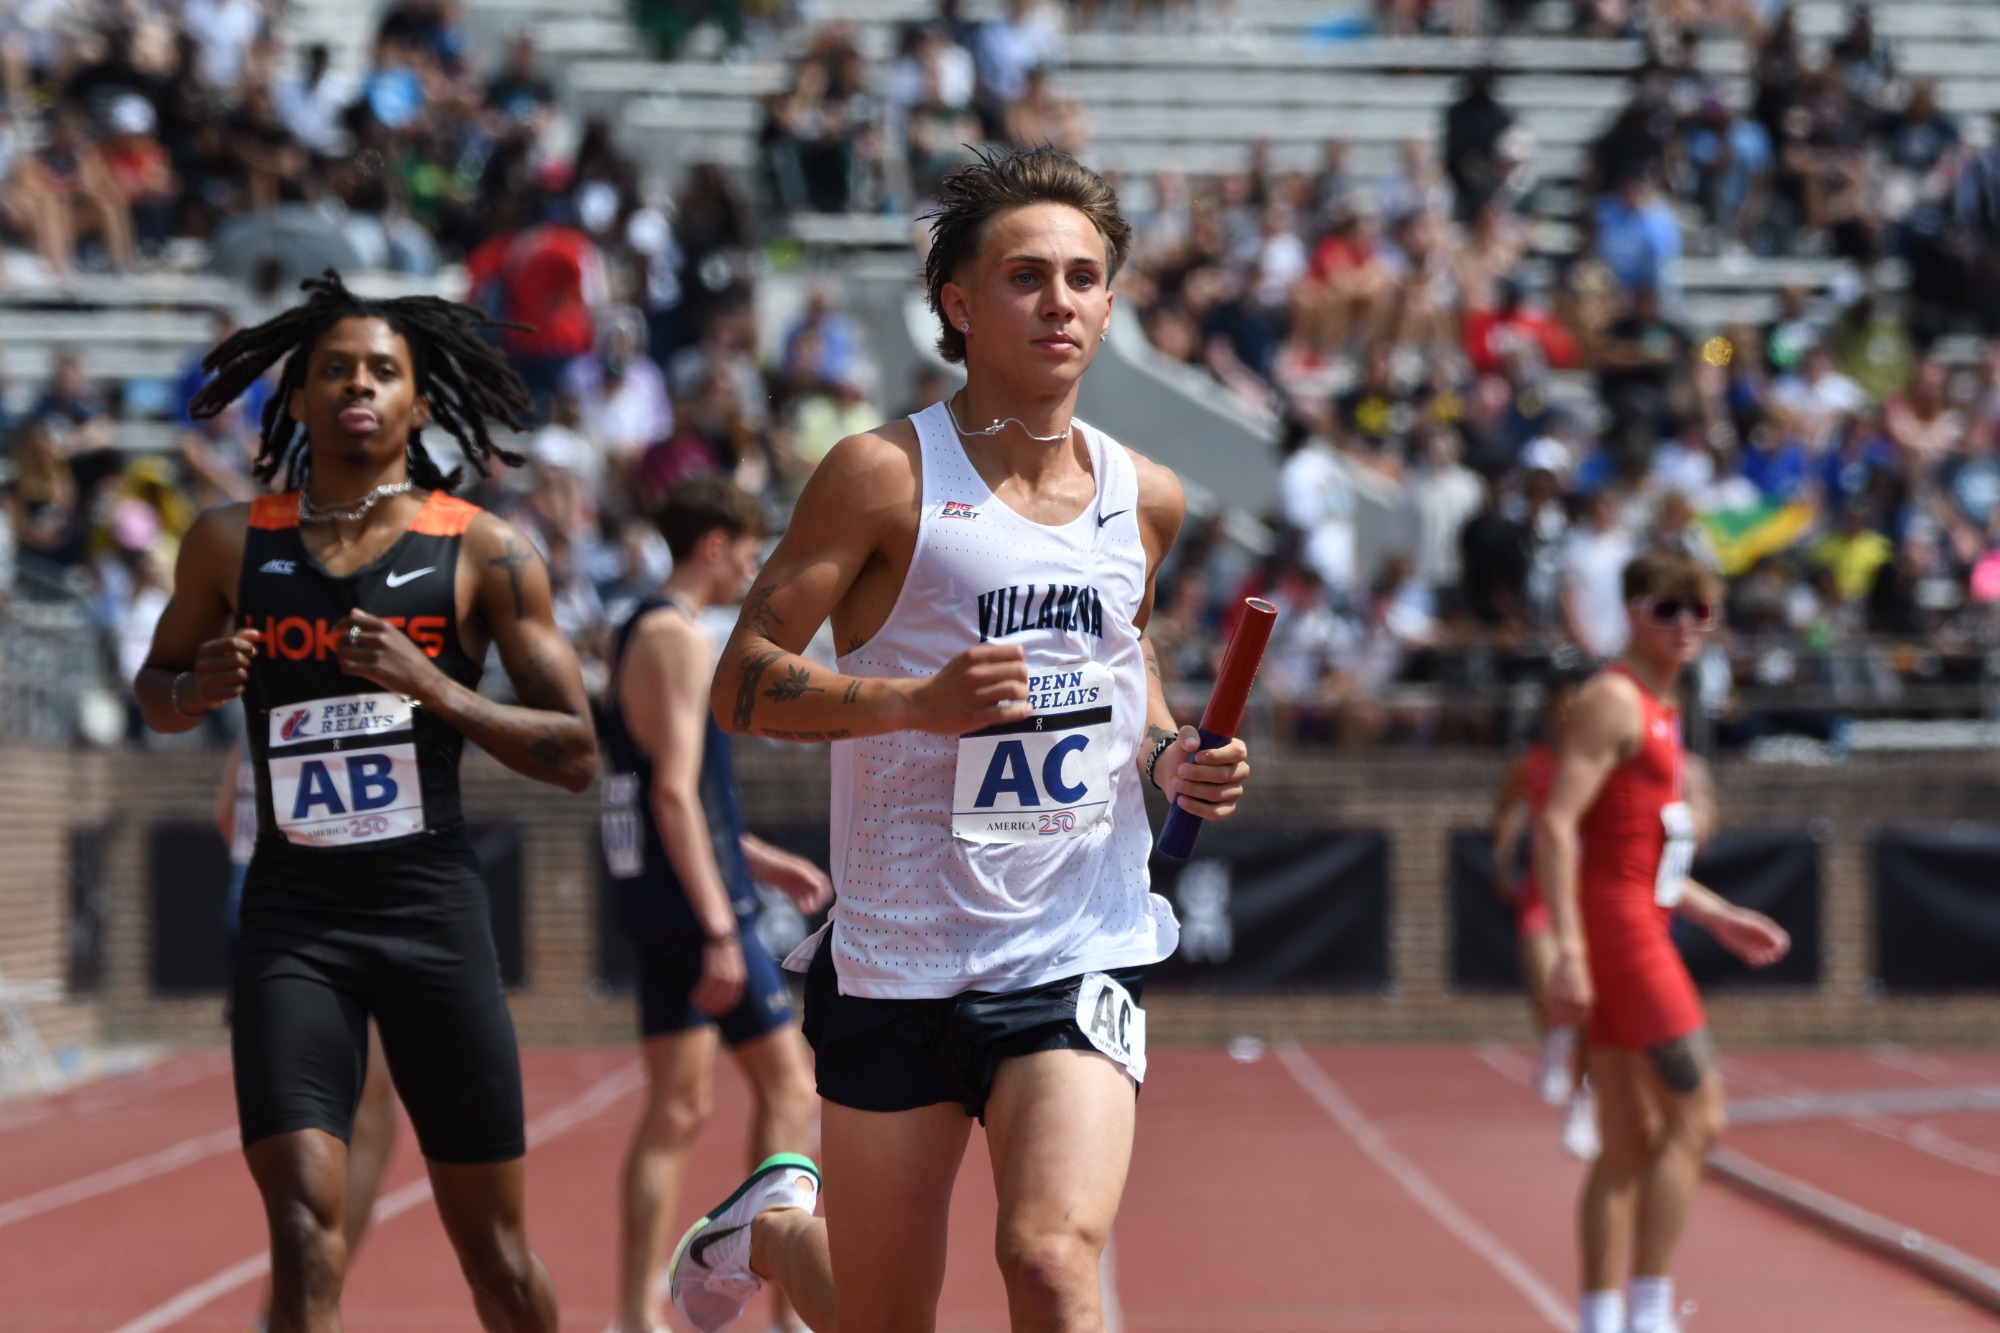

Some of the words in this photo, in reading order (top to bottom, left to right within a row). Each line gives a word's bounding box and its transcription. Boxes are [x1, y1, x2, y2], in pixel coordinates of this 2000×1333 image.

[941, 508, 980, 519] EAST
[945, 501, 974, 512] BIG
[245, 615, 448, 661] HOKS
[1029, 672, 1083, 692] PENN
[322, 701, 377, 719] PENN
[1027, 687, 1100, 710] RELAYS
[320, 714, 394, 734] RELAYS
[974, 734, 1090, 808] AC
[291, 753, 398, 819] AB
[307, 827, 348, 838] AMERICA
[351, 815, 389, 837] 250
[986, 821, 1036, 831] AMERICA
[1038, 811, 1077, 836] 250
[1089, 985, 1131, 1056] AC
